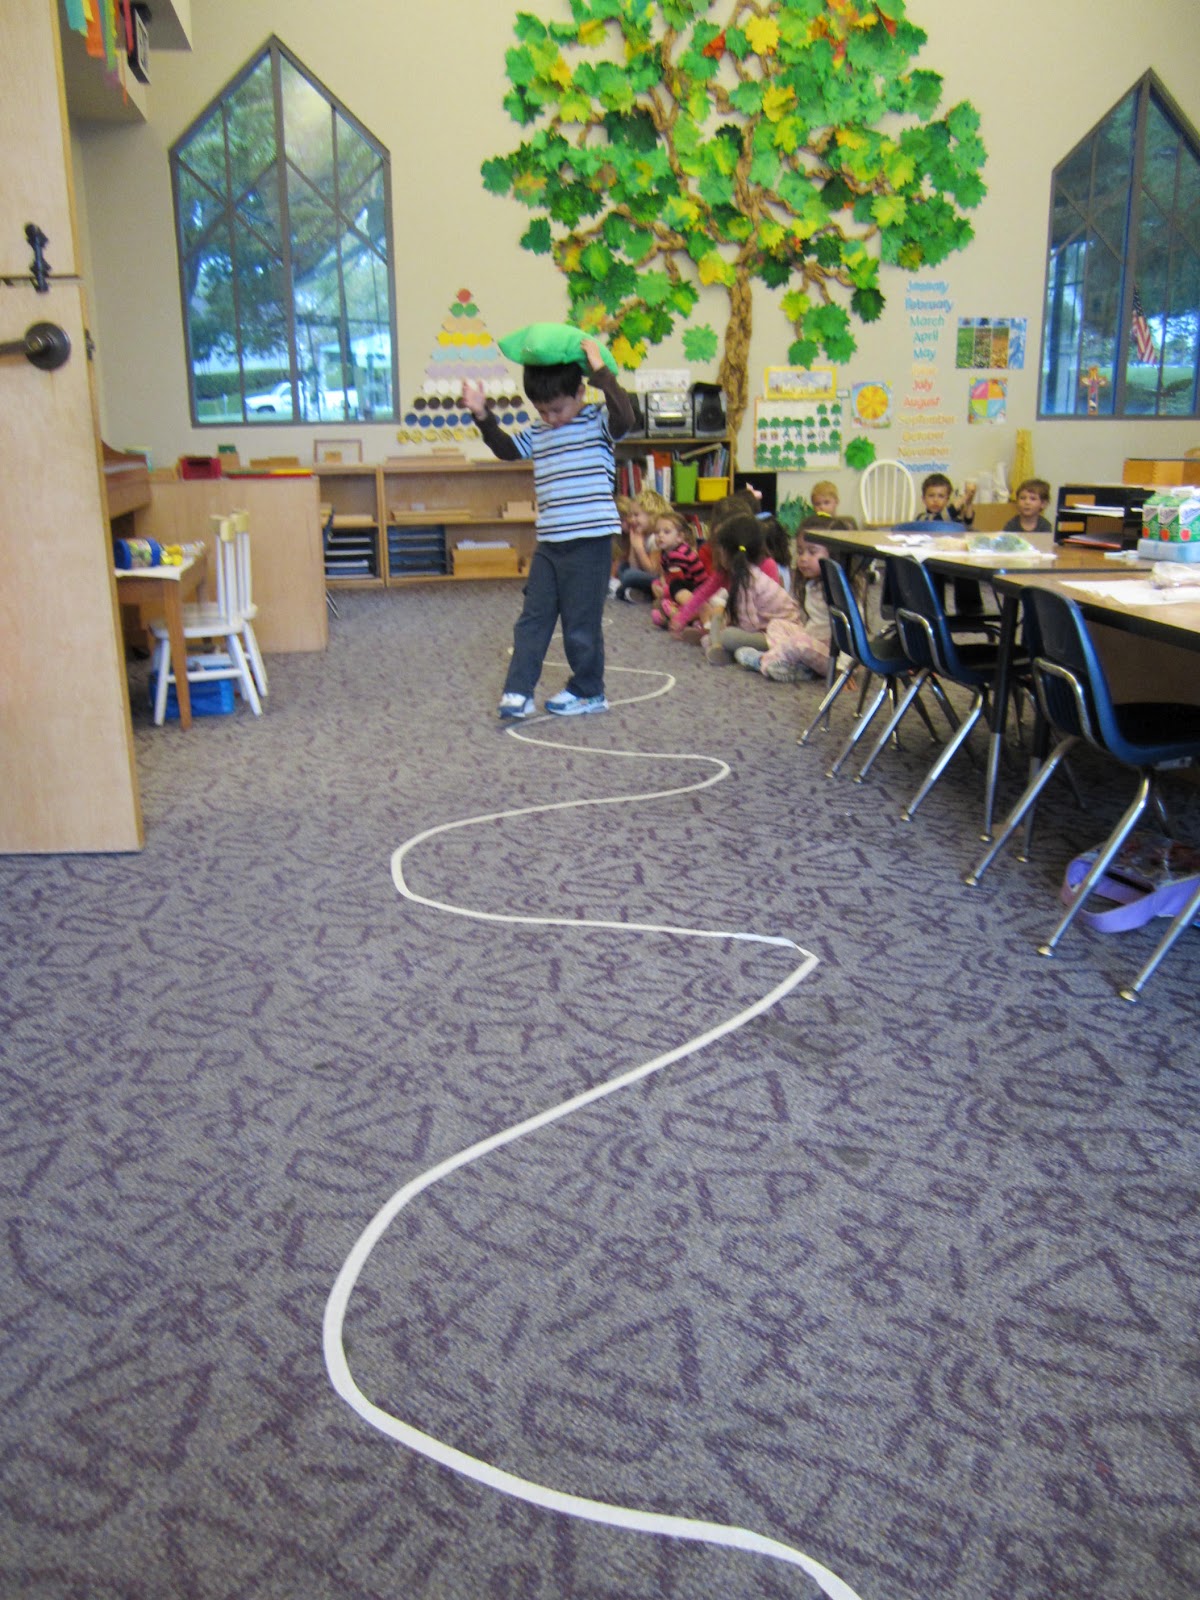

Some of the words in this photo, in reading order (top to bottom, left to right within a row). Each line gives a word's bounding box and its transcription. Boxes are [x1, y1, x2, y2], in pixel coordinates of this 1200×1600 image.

[910, 315, 945, 327] March
[913, 330, 939, 344] April
[913, 347, 936, 361] May
